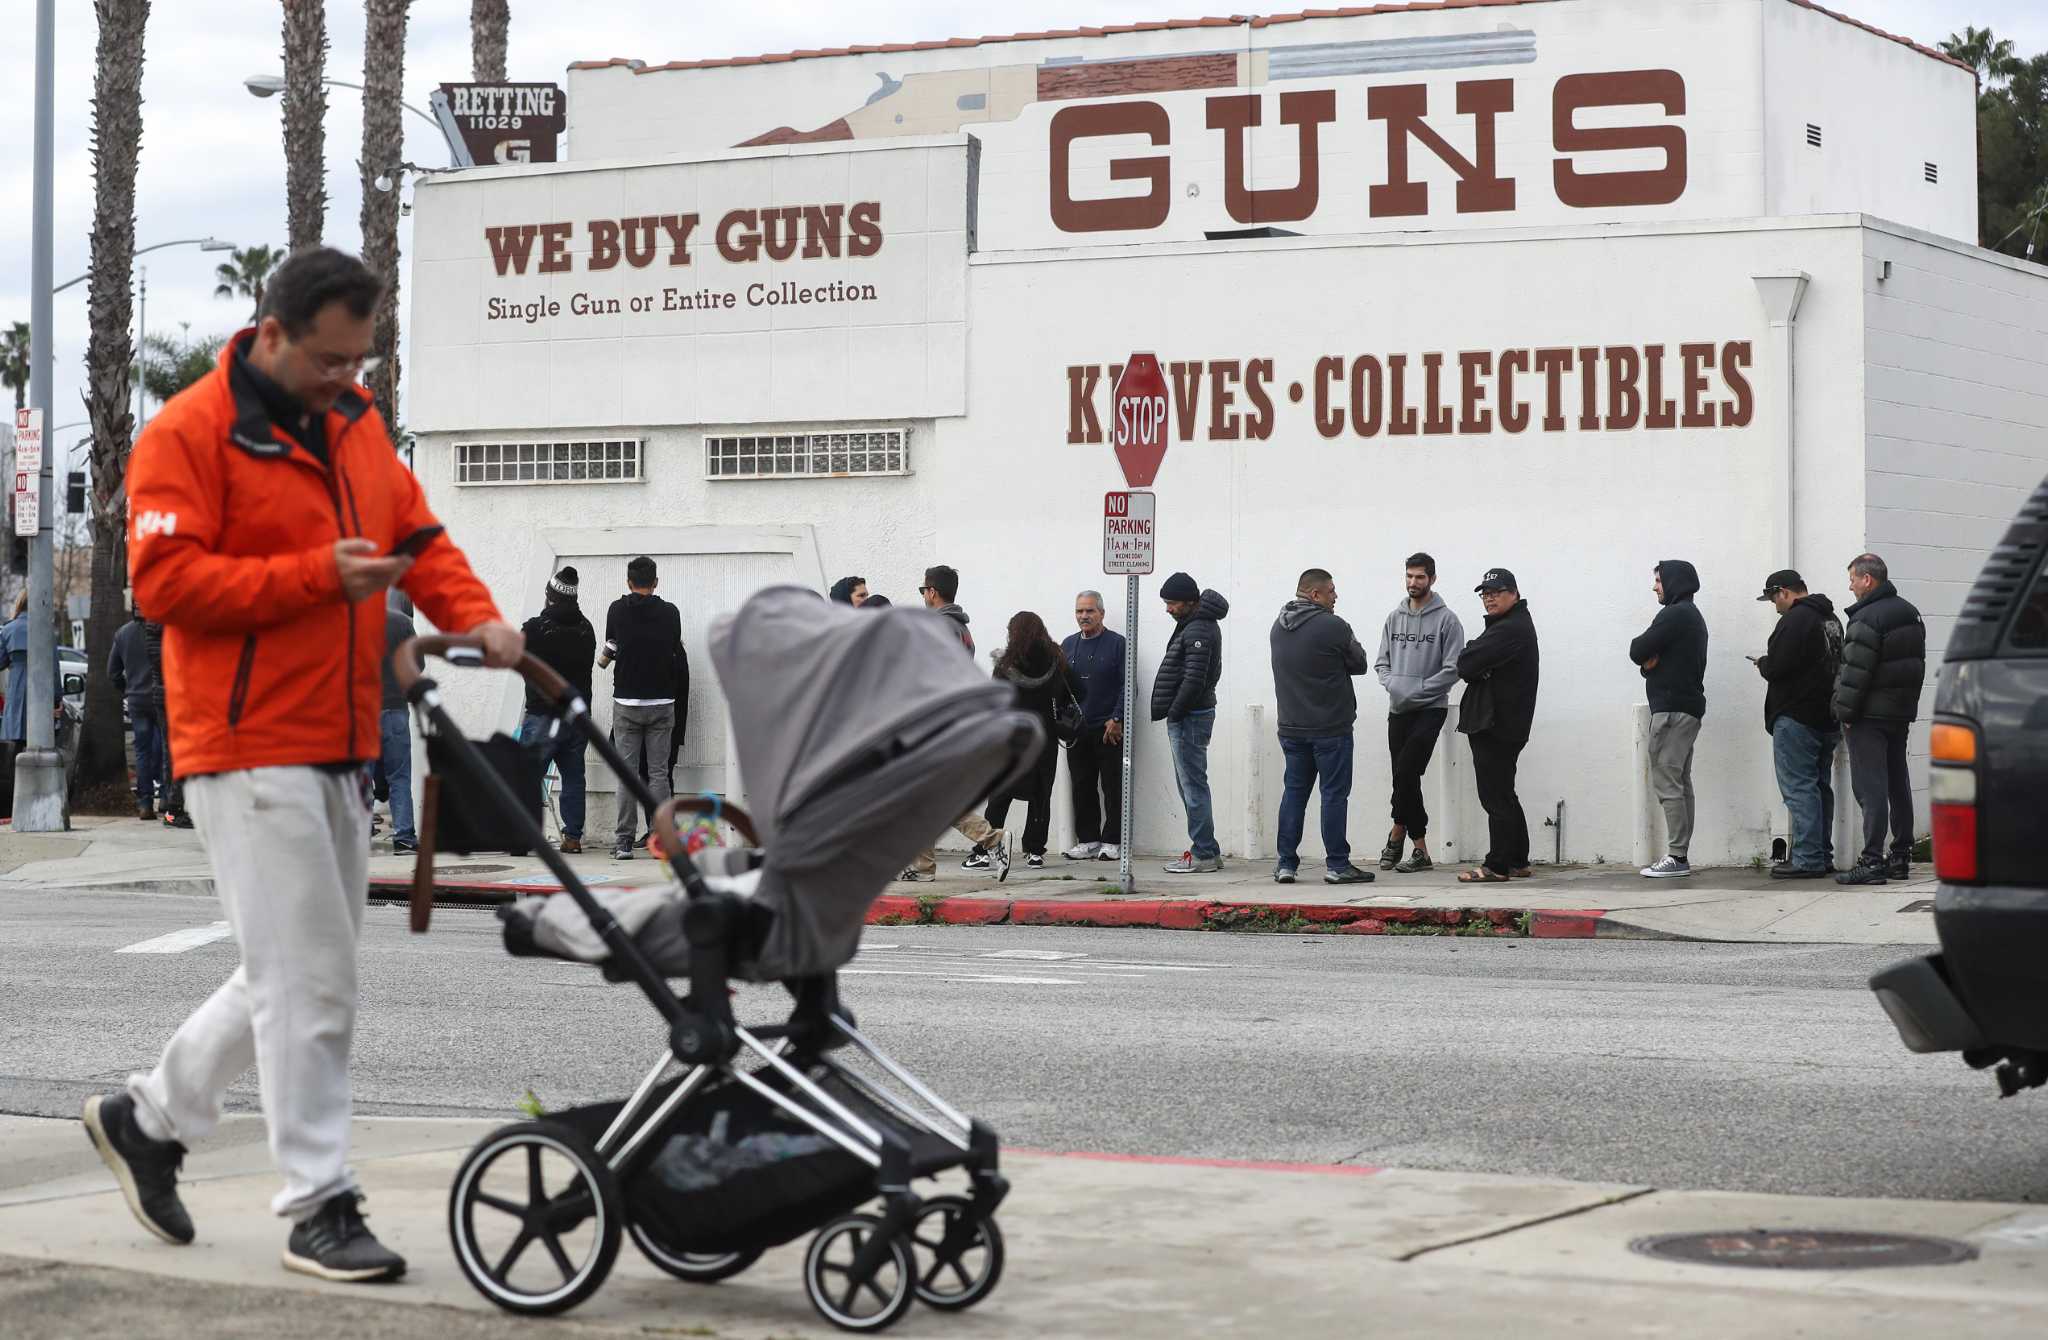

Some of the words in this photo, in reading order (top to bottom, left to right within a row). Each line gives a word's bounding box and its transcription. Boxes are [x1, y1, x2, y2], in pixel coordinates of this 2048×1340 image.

[452, 87, 556, 116] RETTING
[470, 116, 522, 129] 11029
[1050, 69, 1688, 232] GUNS
[485, 222, 573, 277] WE
[587, 213, 700, 271] BUY
[715, 201, 884, 264] GUNS
[487, 297, 561, 323] Single
[570, 292, 621, 316] Gun
[629, 298, 654, 313] or
[662, 287, 737, 312] Entire
[746, 279, 878, 308] Collection
[1066, 357, 1276, 443] KVES
[1314, 340, 1754, 438] COLLECTIBLES
[1117, 395, 1166, 446] STOP
[17, 475, 26, 490] NO
[1108, 495, 1126, 514] NO
[1108, 519, 1151, 535] PARKING
[1391, 632, 1436, 644] ROGUE
